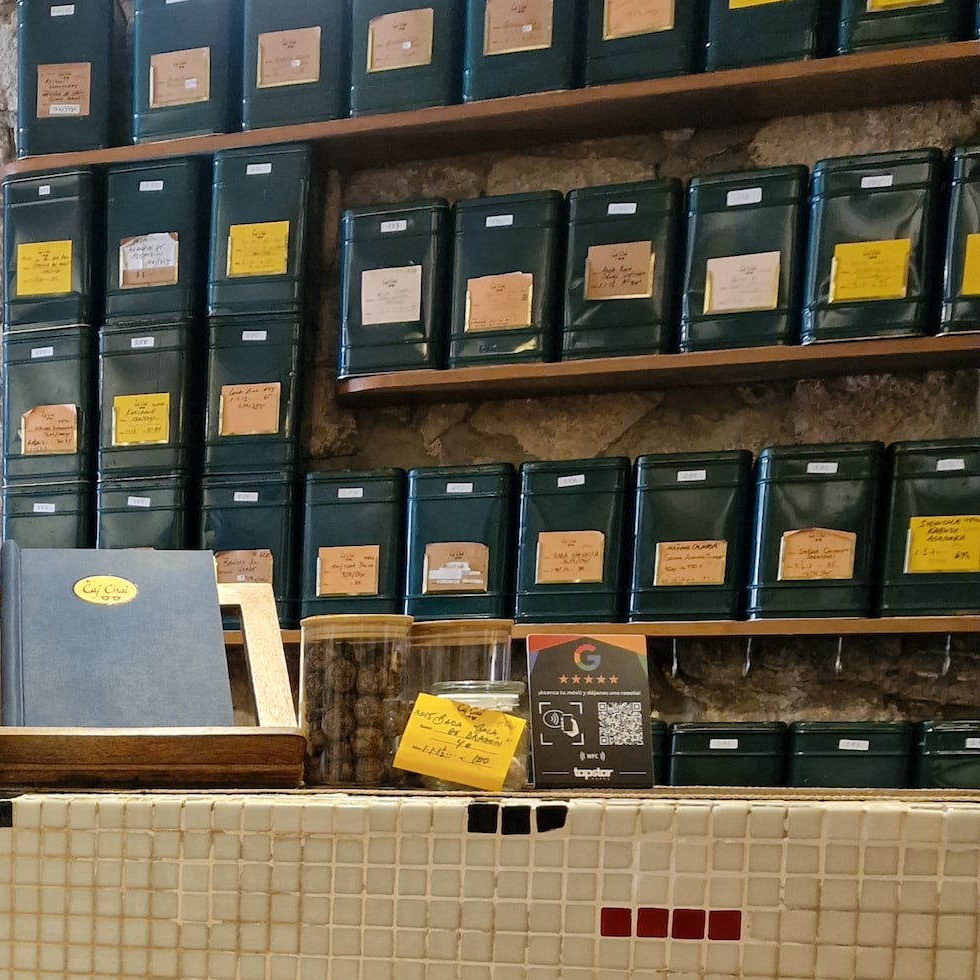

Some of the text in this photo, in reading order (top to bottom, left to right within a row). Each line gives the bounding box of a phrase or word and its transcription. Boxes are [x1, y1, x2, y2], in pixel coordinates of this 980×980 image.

[104, 584, 129, 595] Chai
[573, 643, 601, 671] G
[573, 767, 614, 780] tapstar
